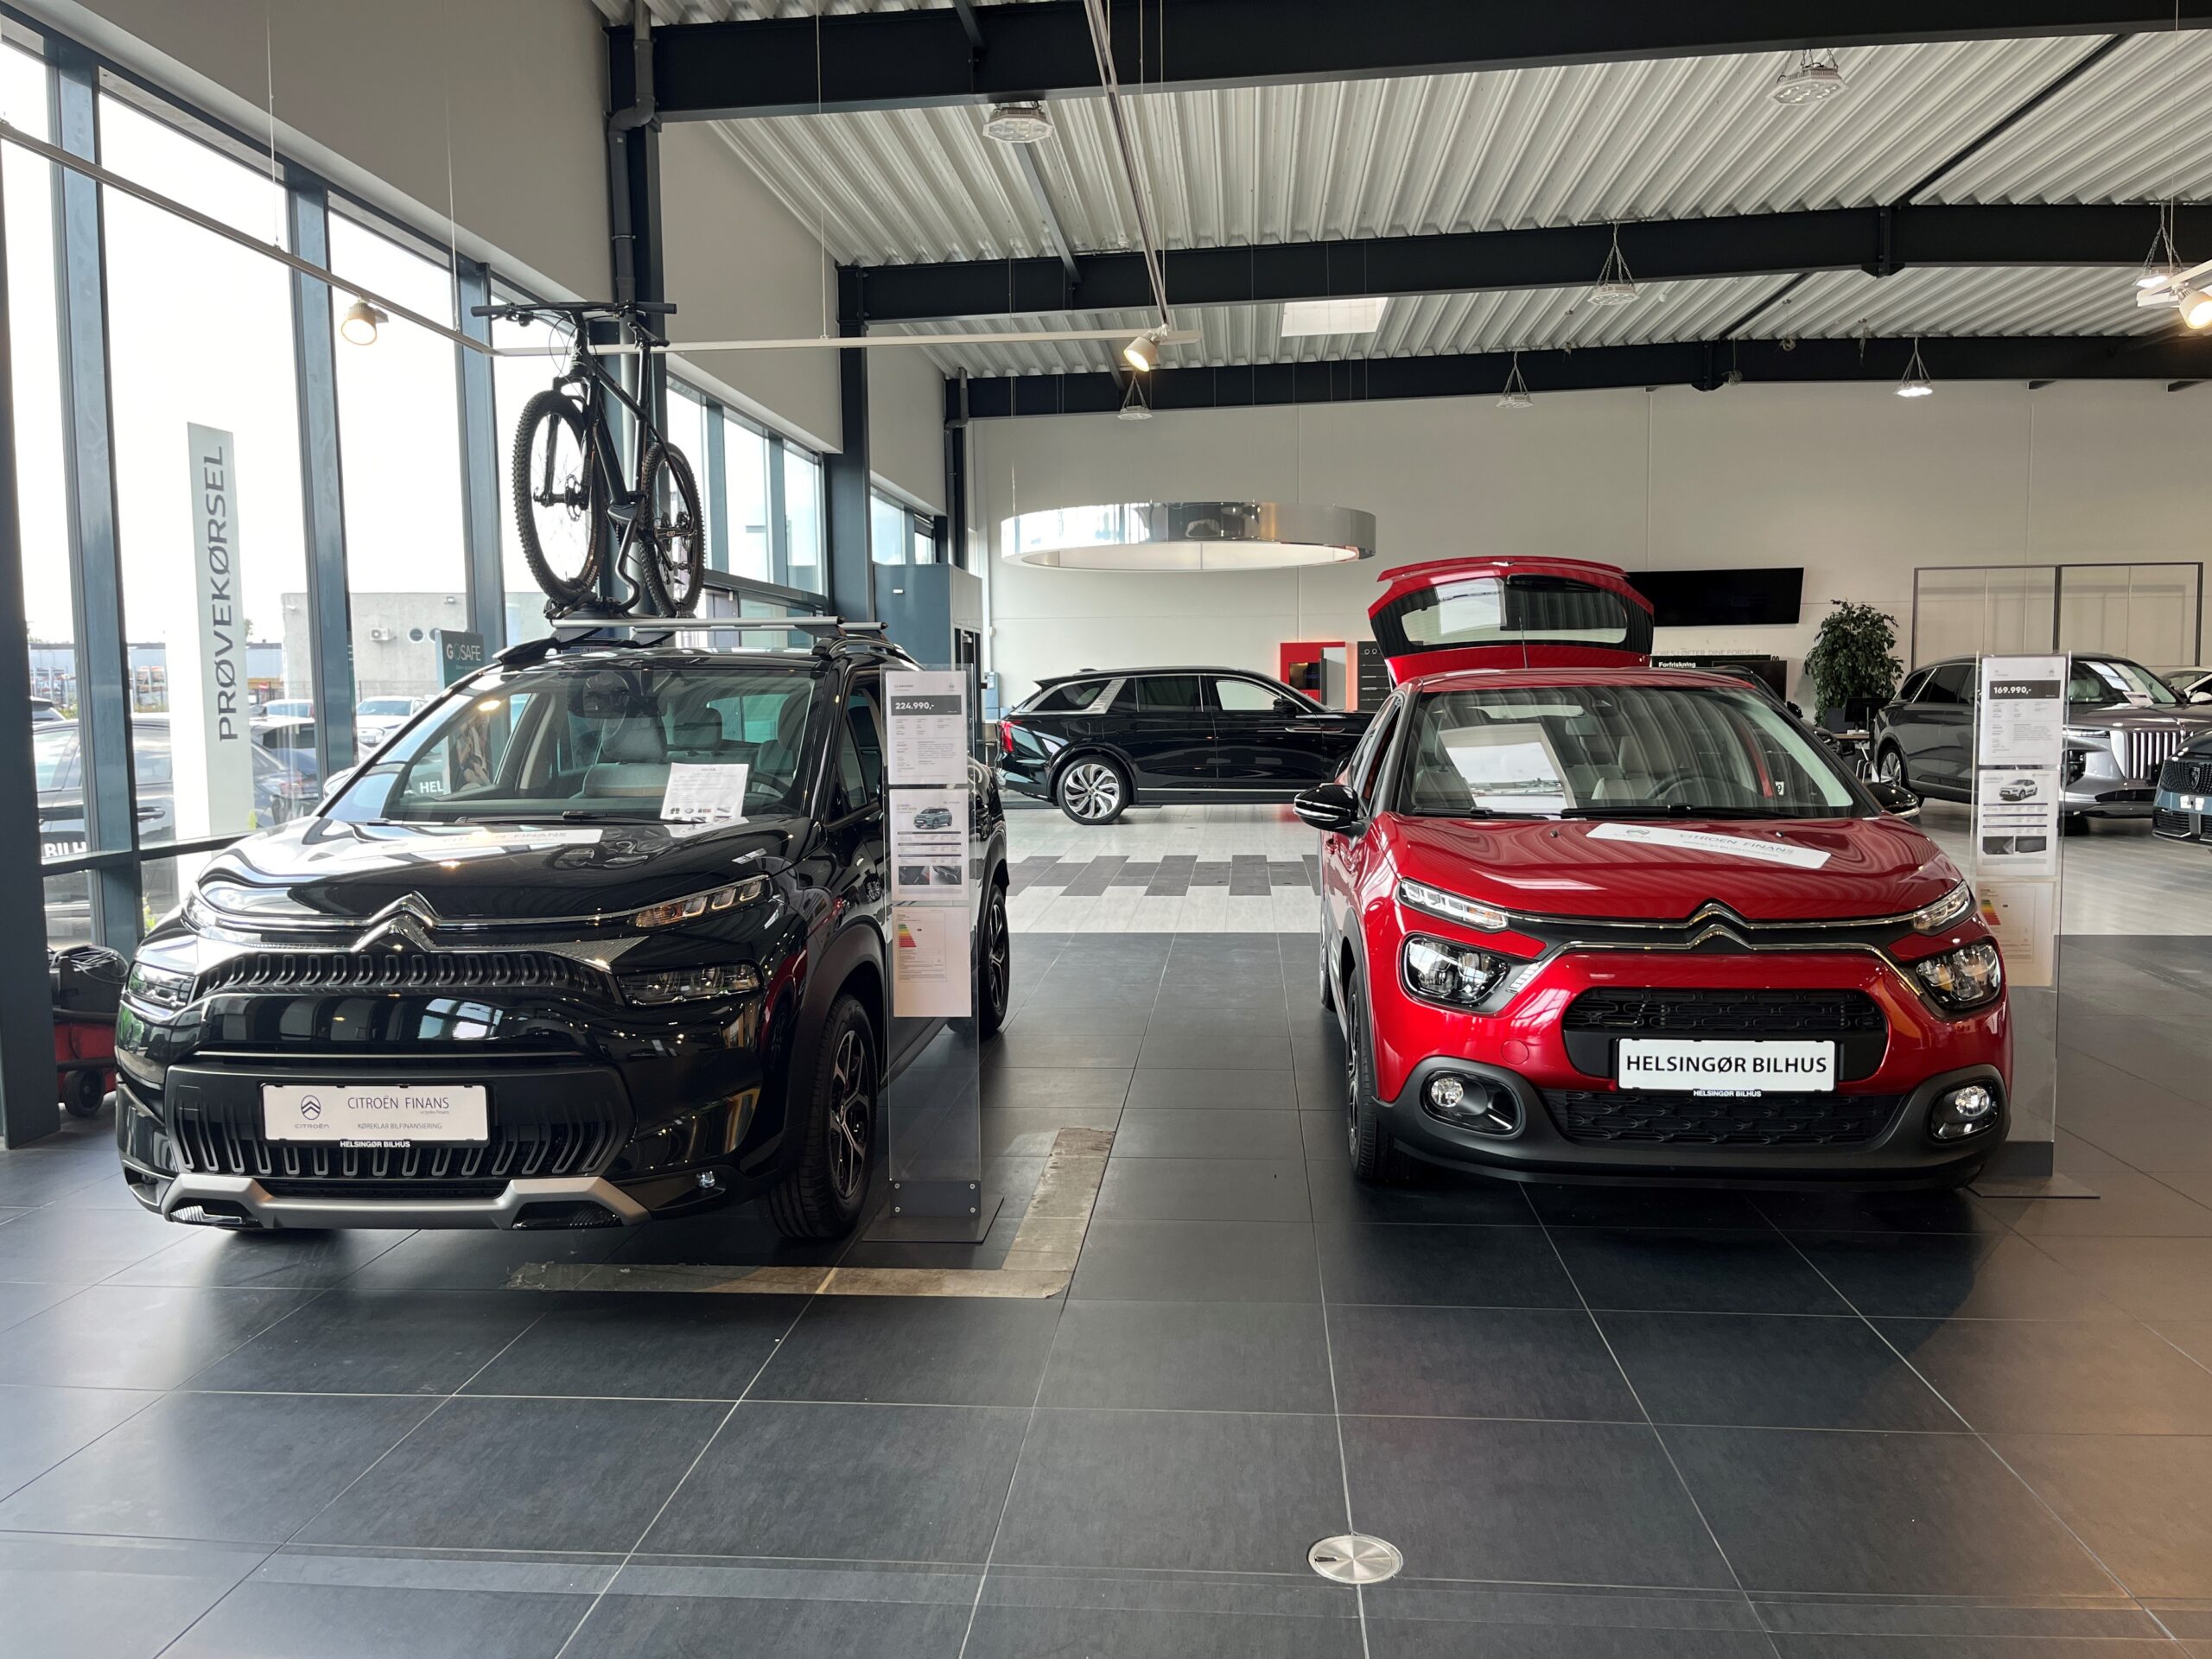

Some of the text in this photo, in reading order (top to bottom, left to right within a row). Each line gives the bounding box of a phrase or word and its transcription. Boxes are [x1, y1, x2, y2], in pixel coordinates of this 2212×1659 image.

[203, 445, 238, 742] PRØVEKØRSEL
[446, 643, 481, 662] GOSAFE
[1993, 686, 2032, 695] 169.990,-
[894, 702, 935, 710] 224.990,-
[1743, 842, 1796, 854] FINANS
[1626, 1055, 1827, 1073] HELSINGØR BILHUS
[347, 1095, 449, 1109] CITROËN FINANS
